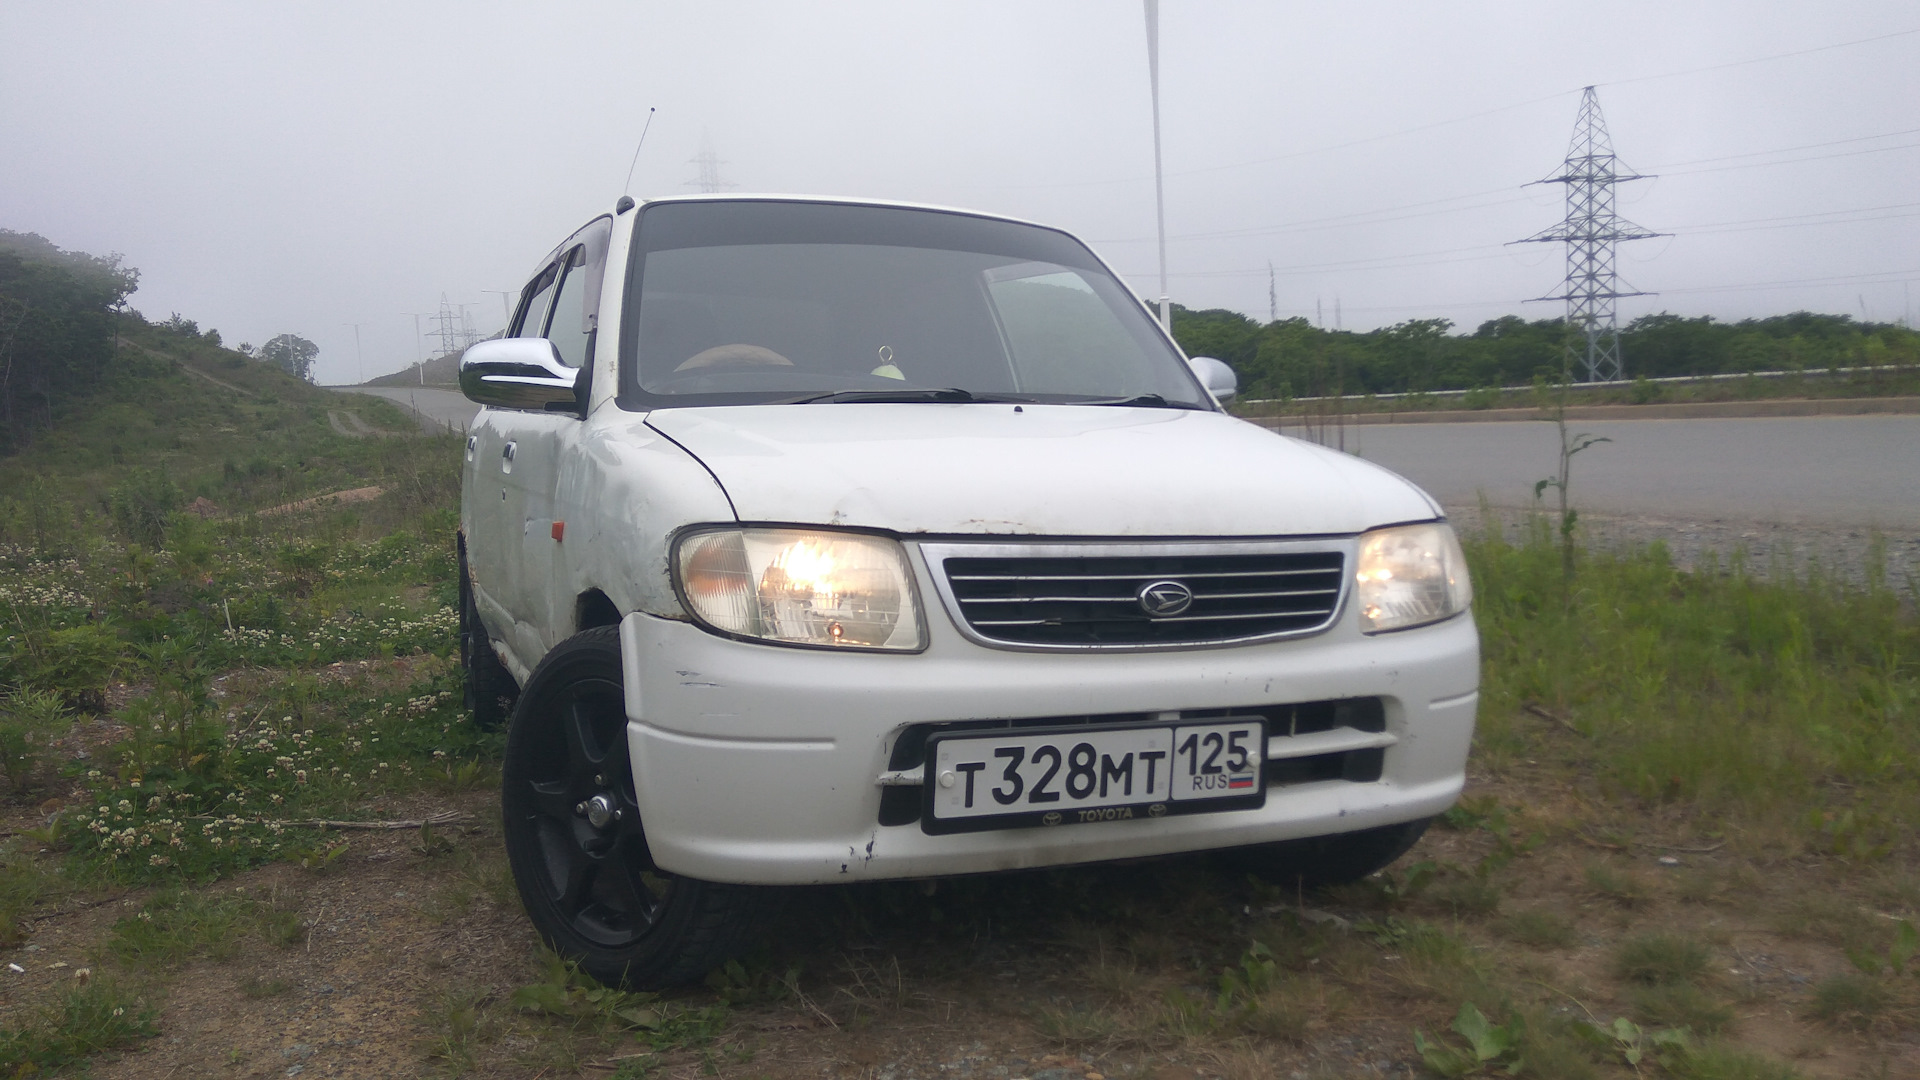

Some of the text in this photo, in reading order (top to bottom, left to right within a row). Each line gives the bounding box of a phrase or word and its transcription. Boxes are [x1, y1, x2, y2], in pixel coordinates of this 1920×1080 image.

[955, 730, 1249, 809] T328MT 125
[1192, 774, 1228, 791] RUS
[1078, 807, 1134, 823] TOYOTA
